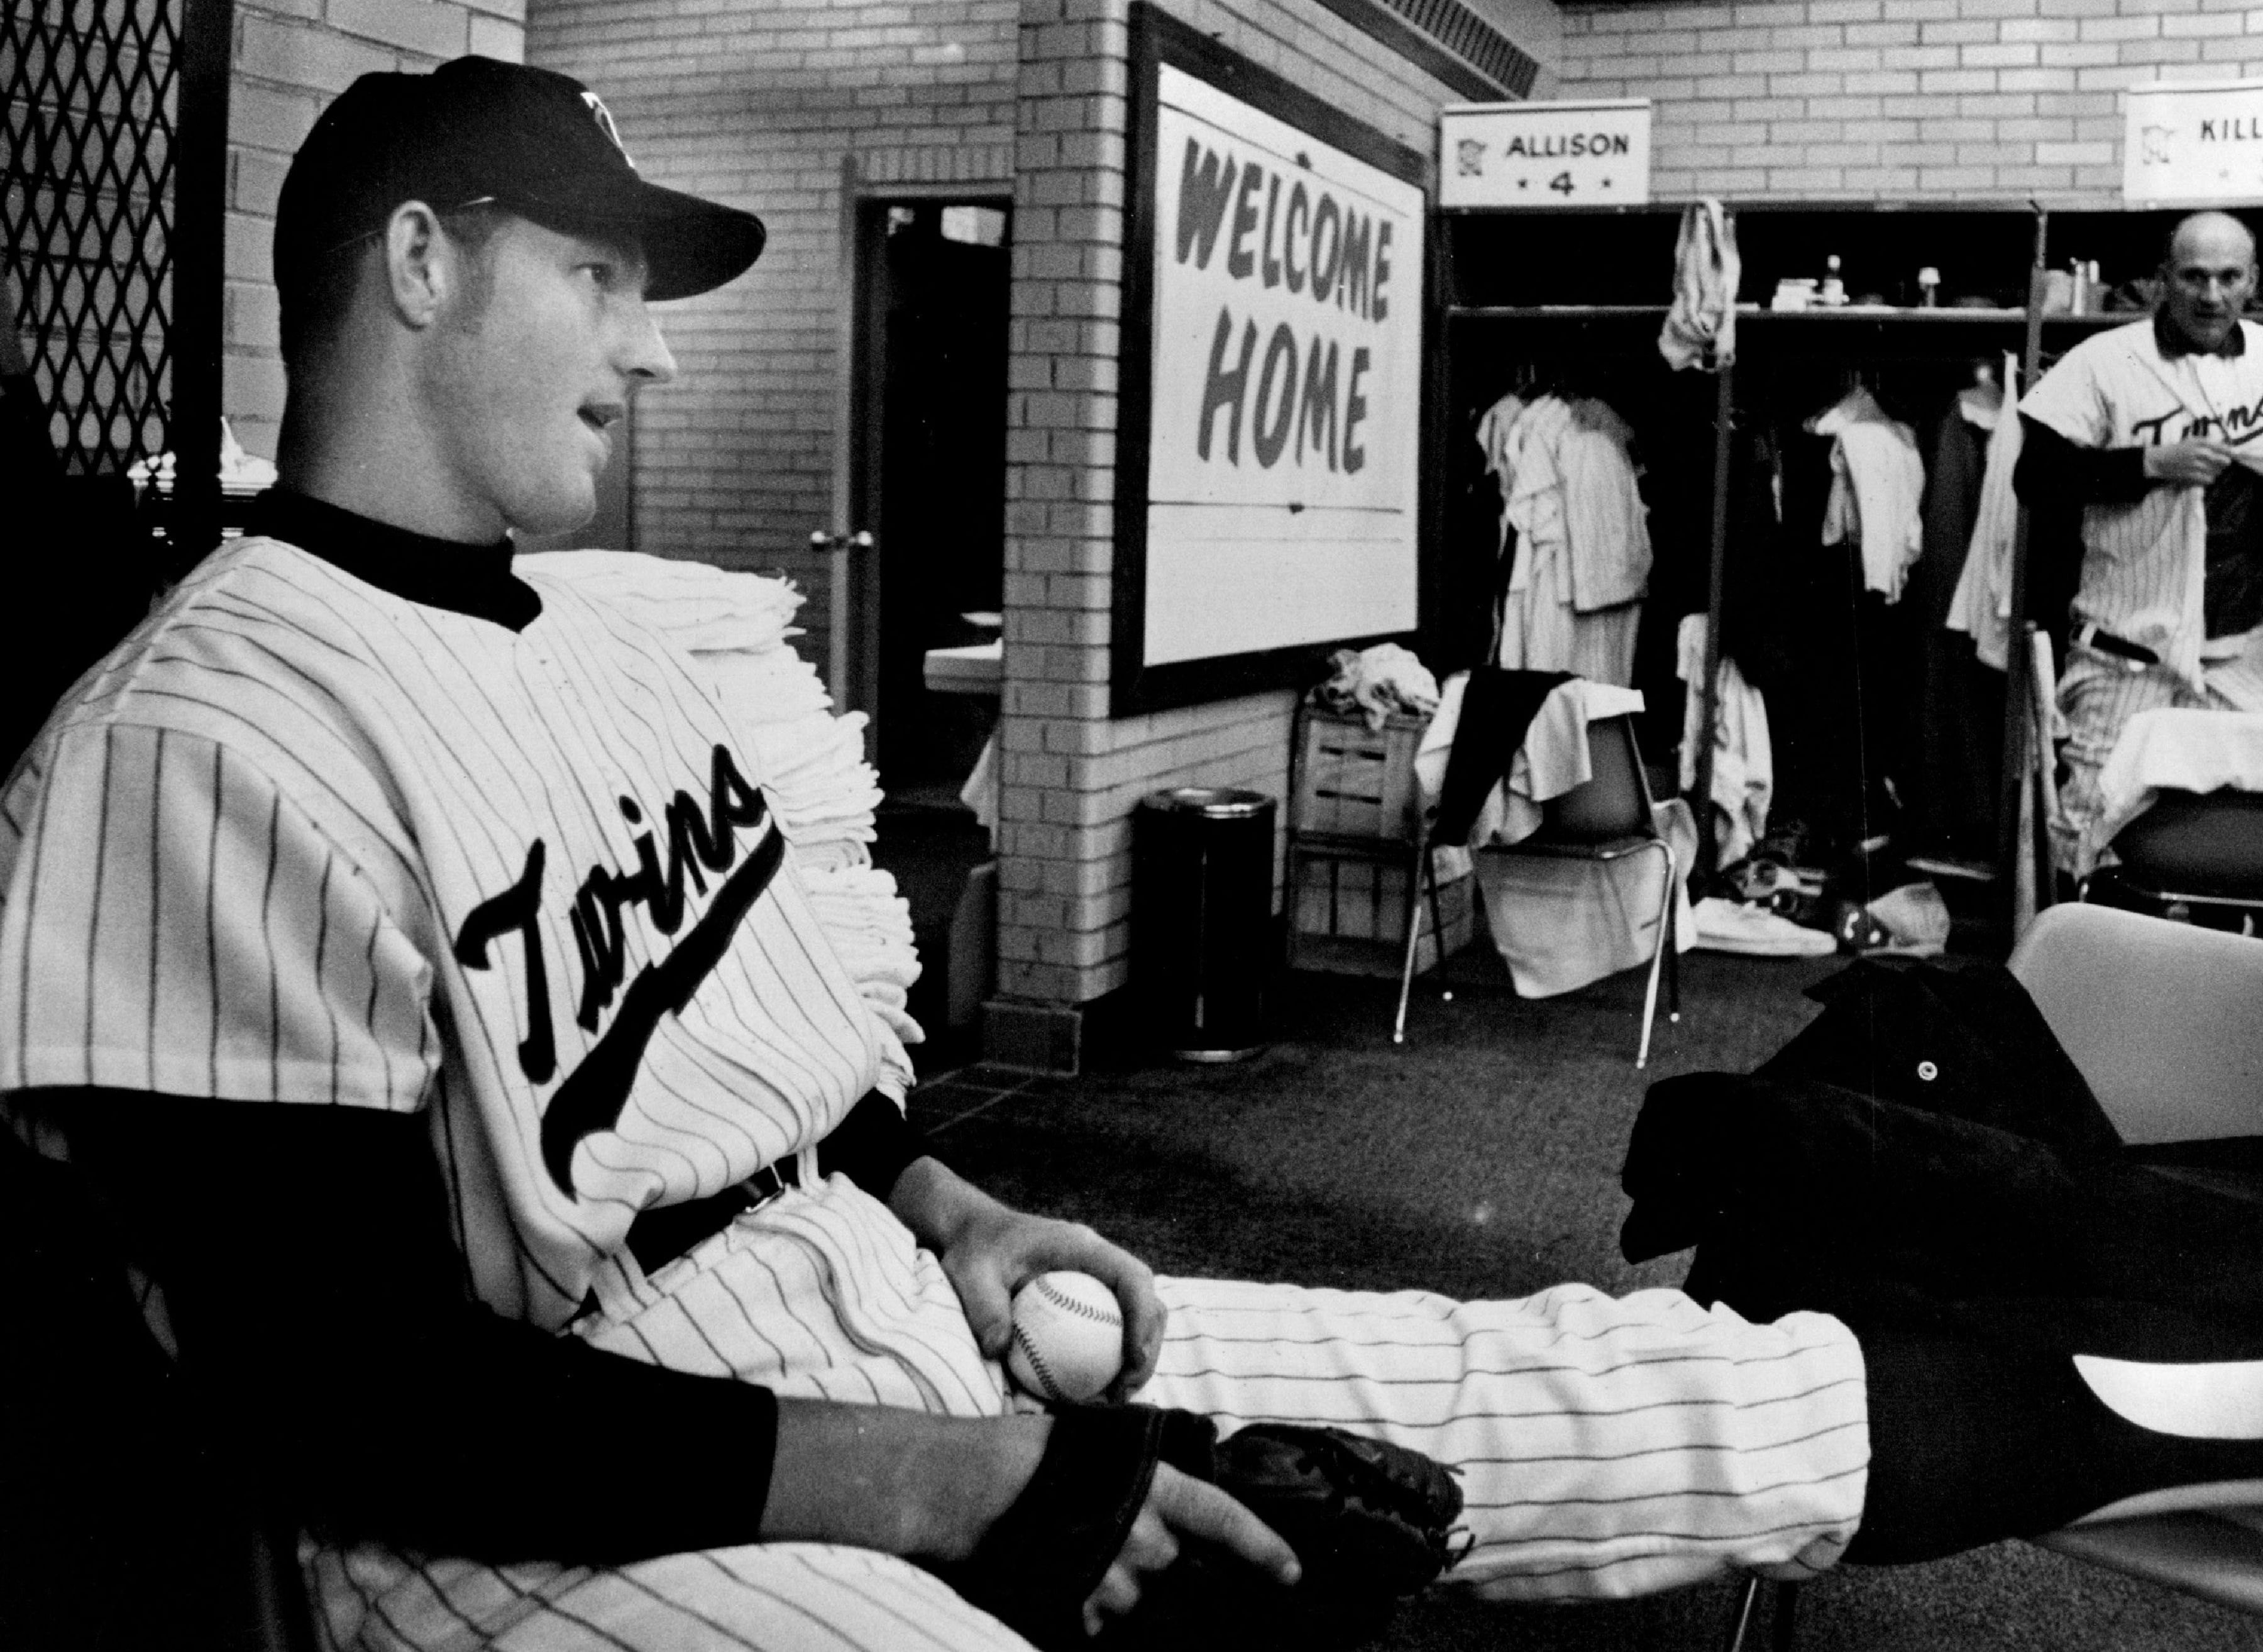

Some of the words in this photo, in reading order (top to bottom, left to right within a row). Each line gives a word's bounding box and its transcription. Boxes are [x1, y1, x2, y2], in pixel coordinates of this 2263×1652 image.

[1175, 135, 1394, 324] WELCOME
[1506, 133, 1629, 158] ALLISON
[1550, 170, 1575, 196] 4
[1197, 303, 1371, 475] HOME
[454, 743, 768, 1086] Twins
